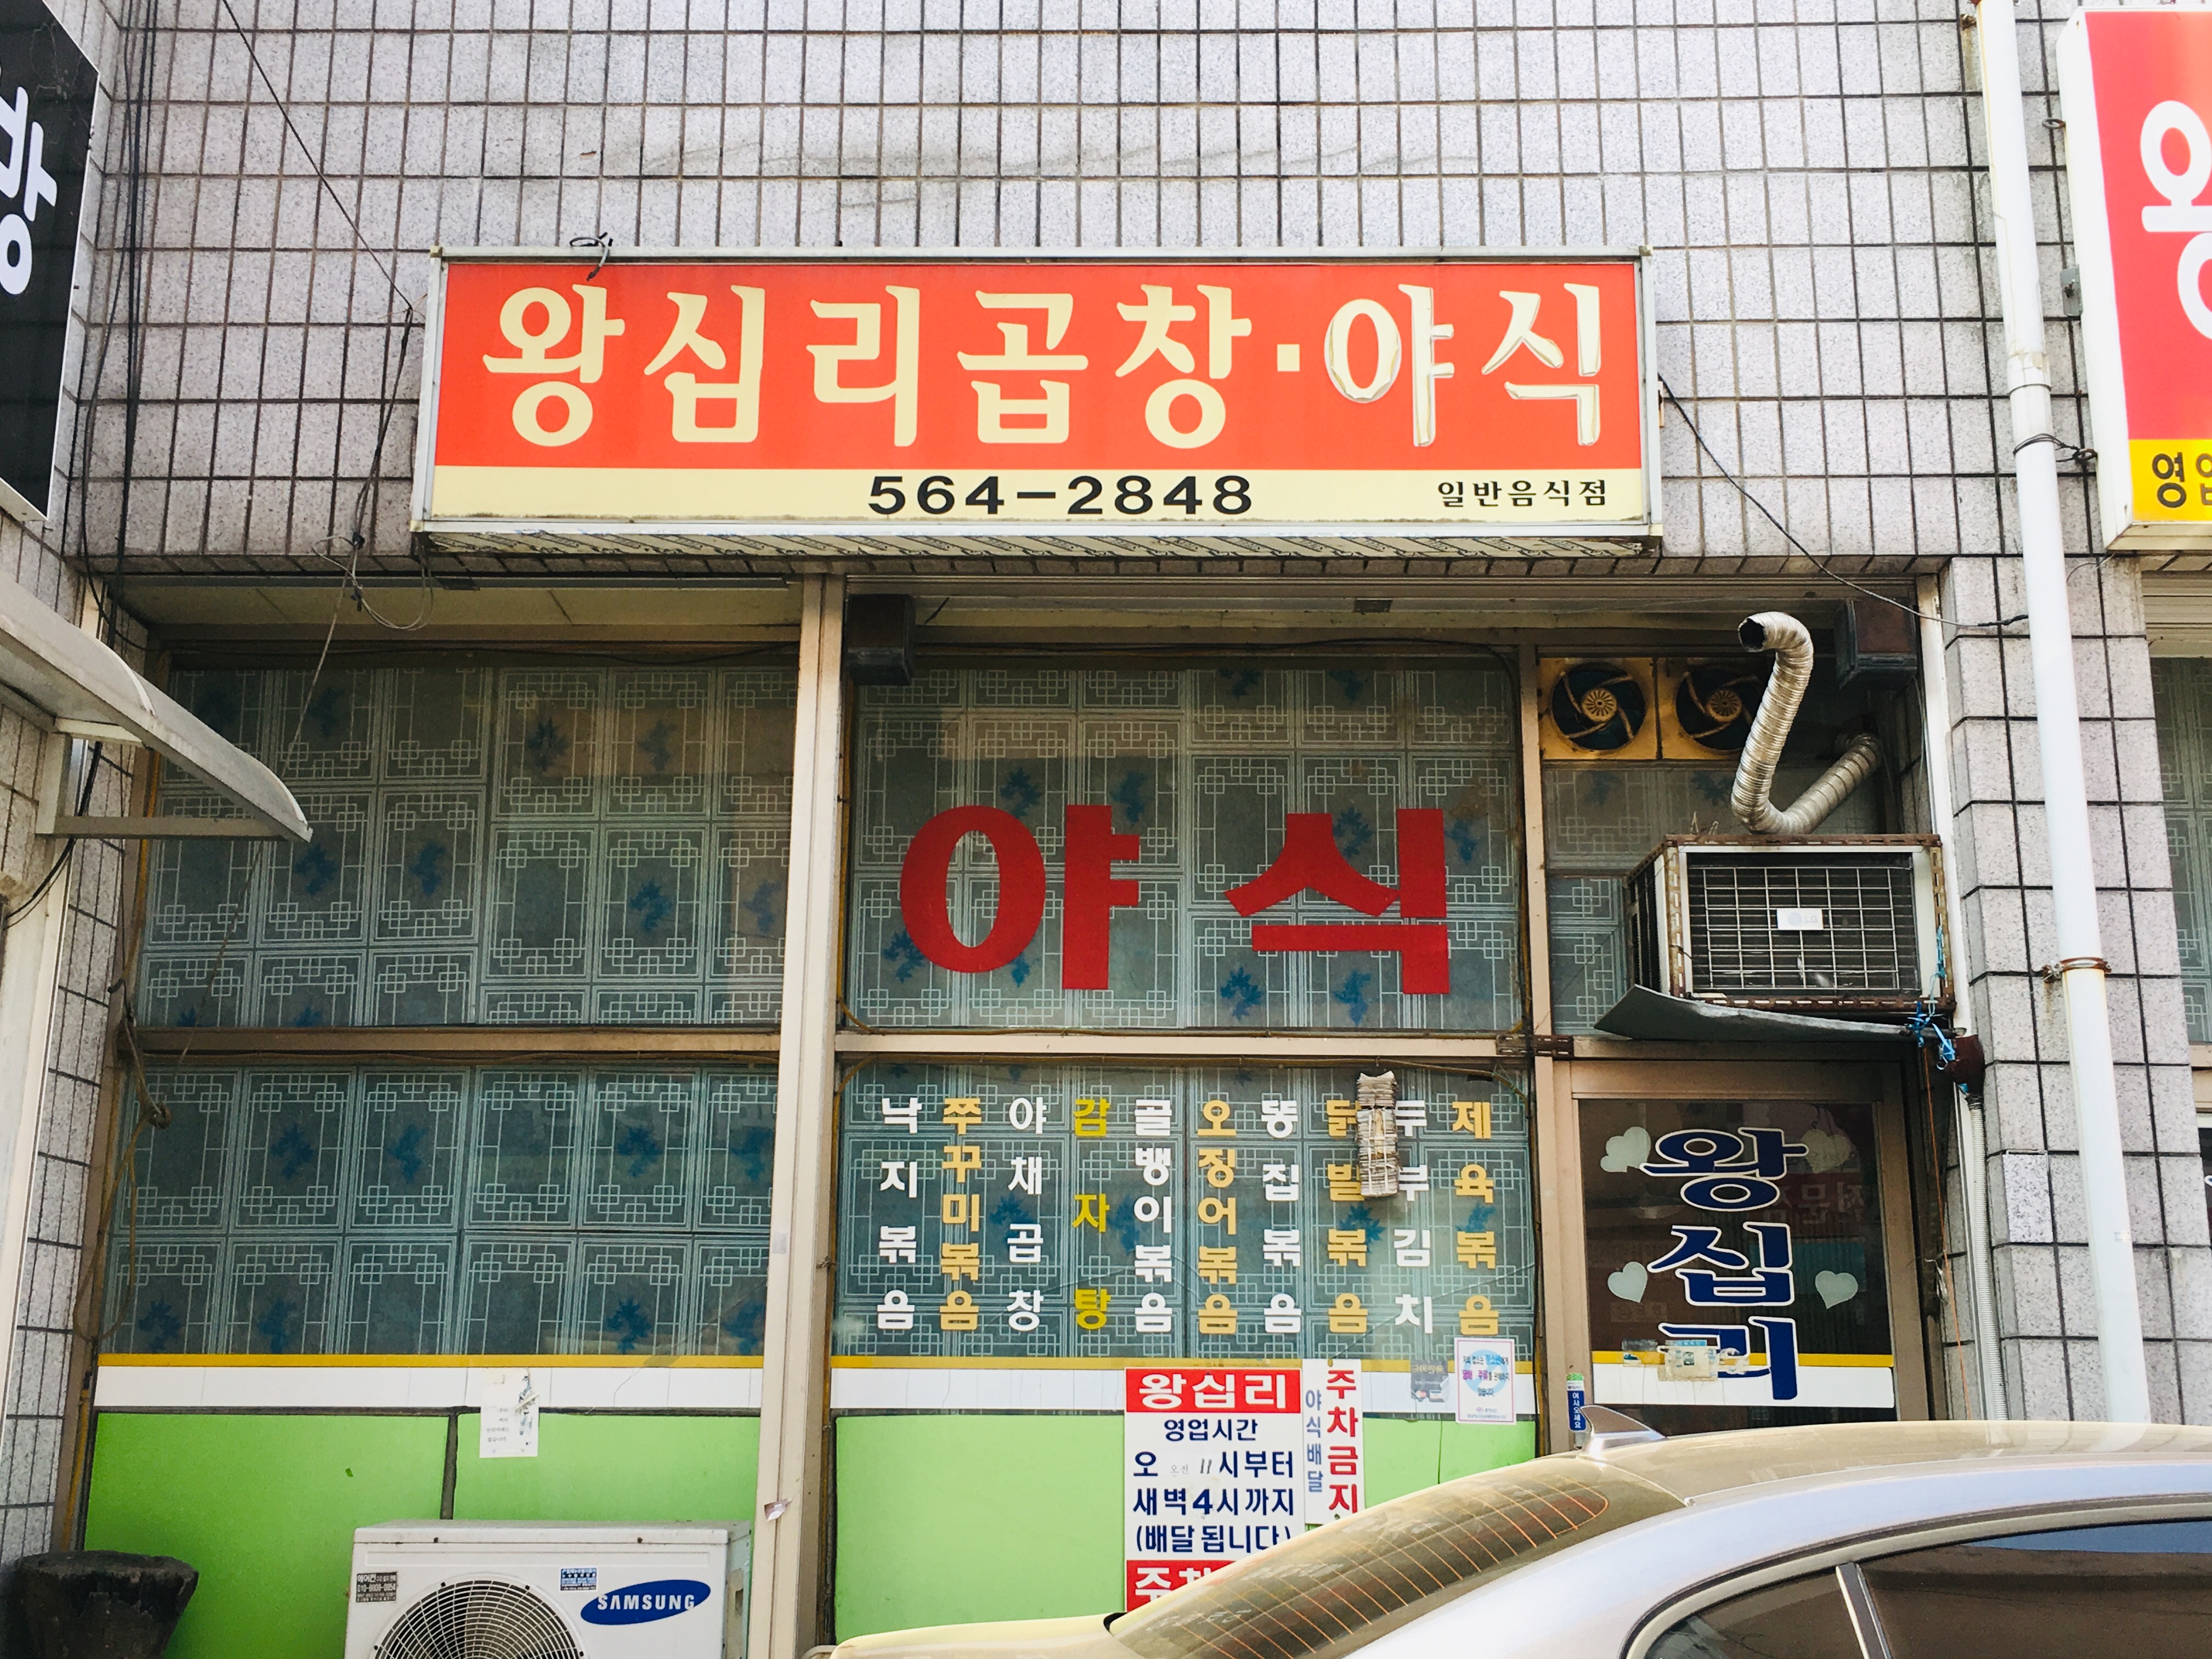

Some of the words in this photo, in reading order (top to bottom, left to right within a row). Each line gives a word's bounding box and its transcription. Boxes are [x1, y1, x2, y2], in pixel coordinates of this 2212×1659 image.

[868, 476, 1251, 515] 564-2848
[1437, 479, 1606, 507] 일반음식점
[900, 804, 1449, 995] 야식
[877, 1097, 922, 1330] 낙지볶음
[939, 1098, 982, 1331] 쭈꾸미볶음
[1007, 1097, 1047, 1331] 야채곱창
[1072, 1098, 1111, 1330] 감자탕
[1134, 1099, 1172, 1333] 골뱅이볶음
[1197, 1099, 1238, 1334] 오징어볶음
[1261, 1099, 1301, 1334] 똥집볶음
[1394, 1099, 1434, 1334] 두부김치
[1452, 1101, 1499, 1335] 제육볶음
[1640, 1127, 1809, 1401] 왕십리
[1139, 1374, 1286, 1409] 왕십리
[1164, 1419, 1258, 1442] 영업시간
[1305, 1390, 1324, 1493] 야식배달
[1326, 1370, 1358, 1514] 주차금지
[597, 1594, 695, 1610] SAMSUNG
